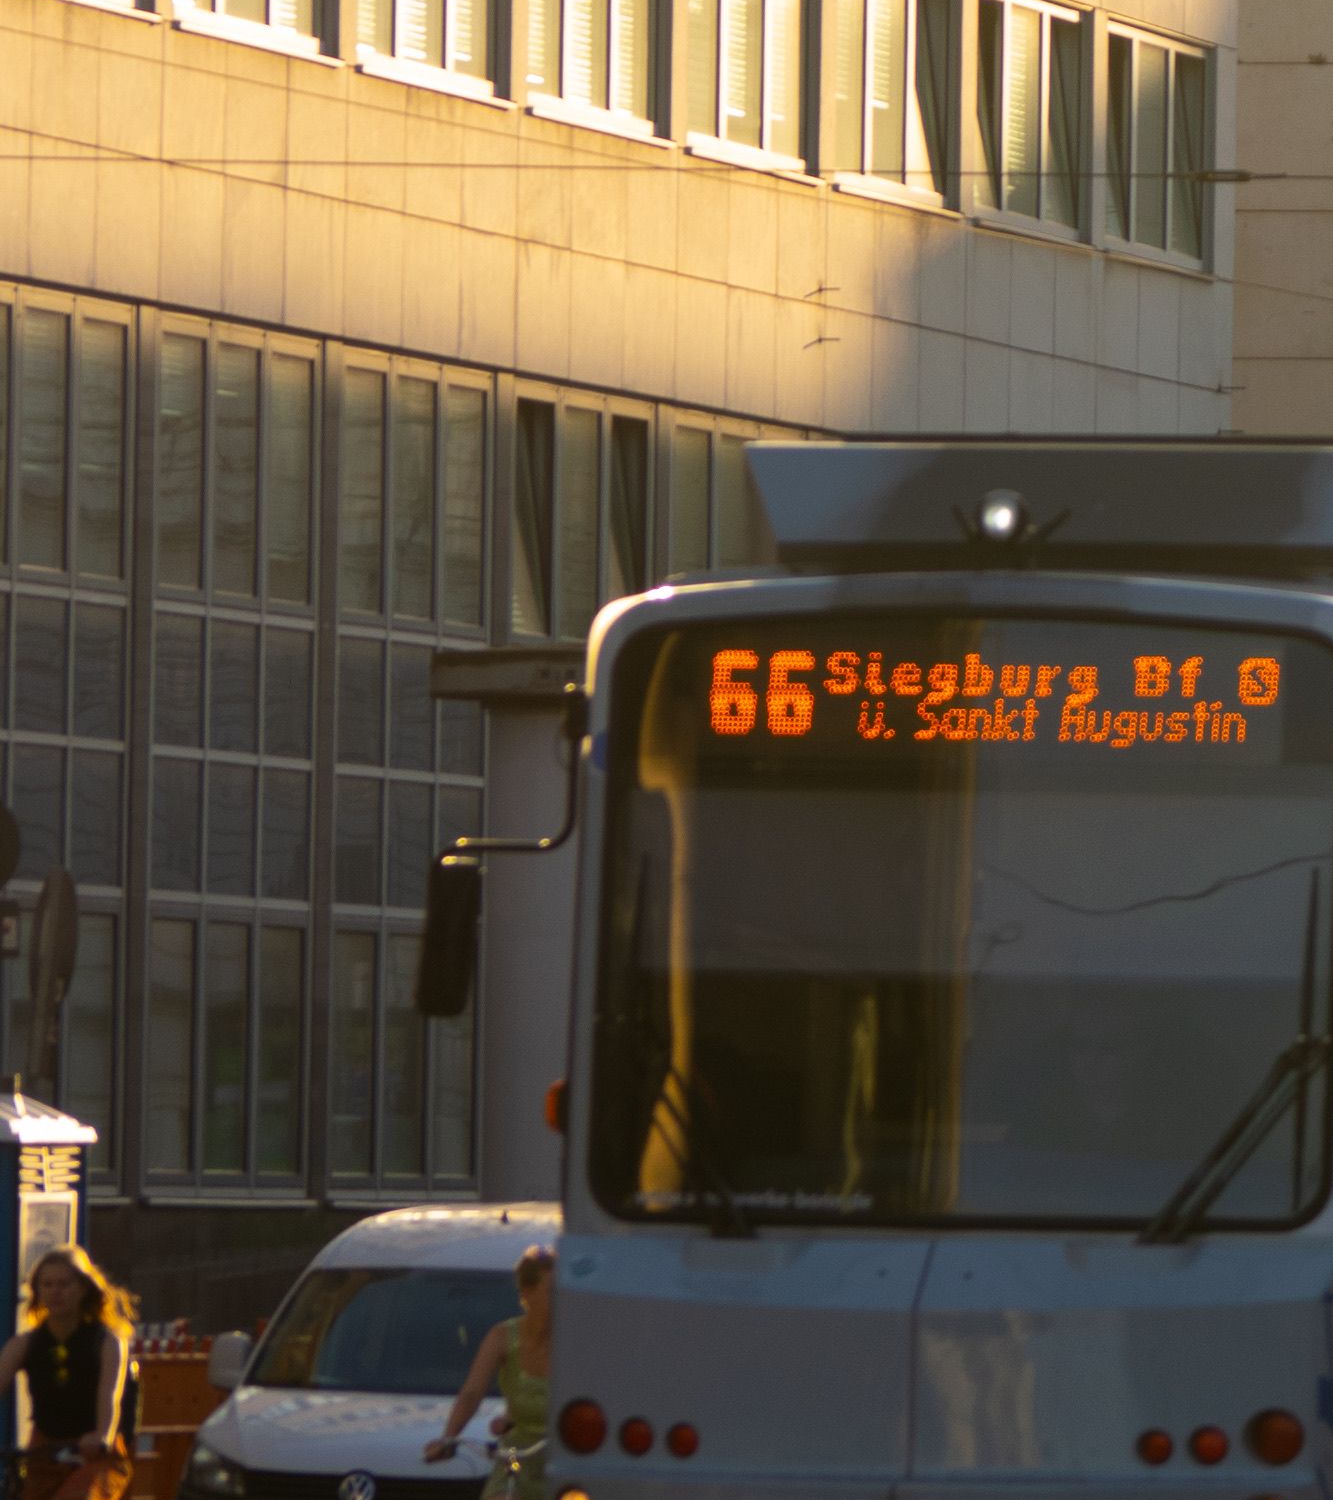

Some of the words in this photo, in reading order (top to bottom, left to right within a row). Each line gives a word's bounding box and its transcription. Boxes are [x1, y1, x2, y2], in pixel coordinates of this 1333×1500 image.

[710, 650, 815, 735] 66
[823, 651, 1099, 706] Siegburg
[1133, 656, 1204, 697] Bf
[857, 702, 896, 739] ü.
[913, 698, 1040, 741] Sankt
[1058, 702, 1247, 748] Augustin
